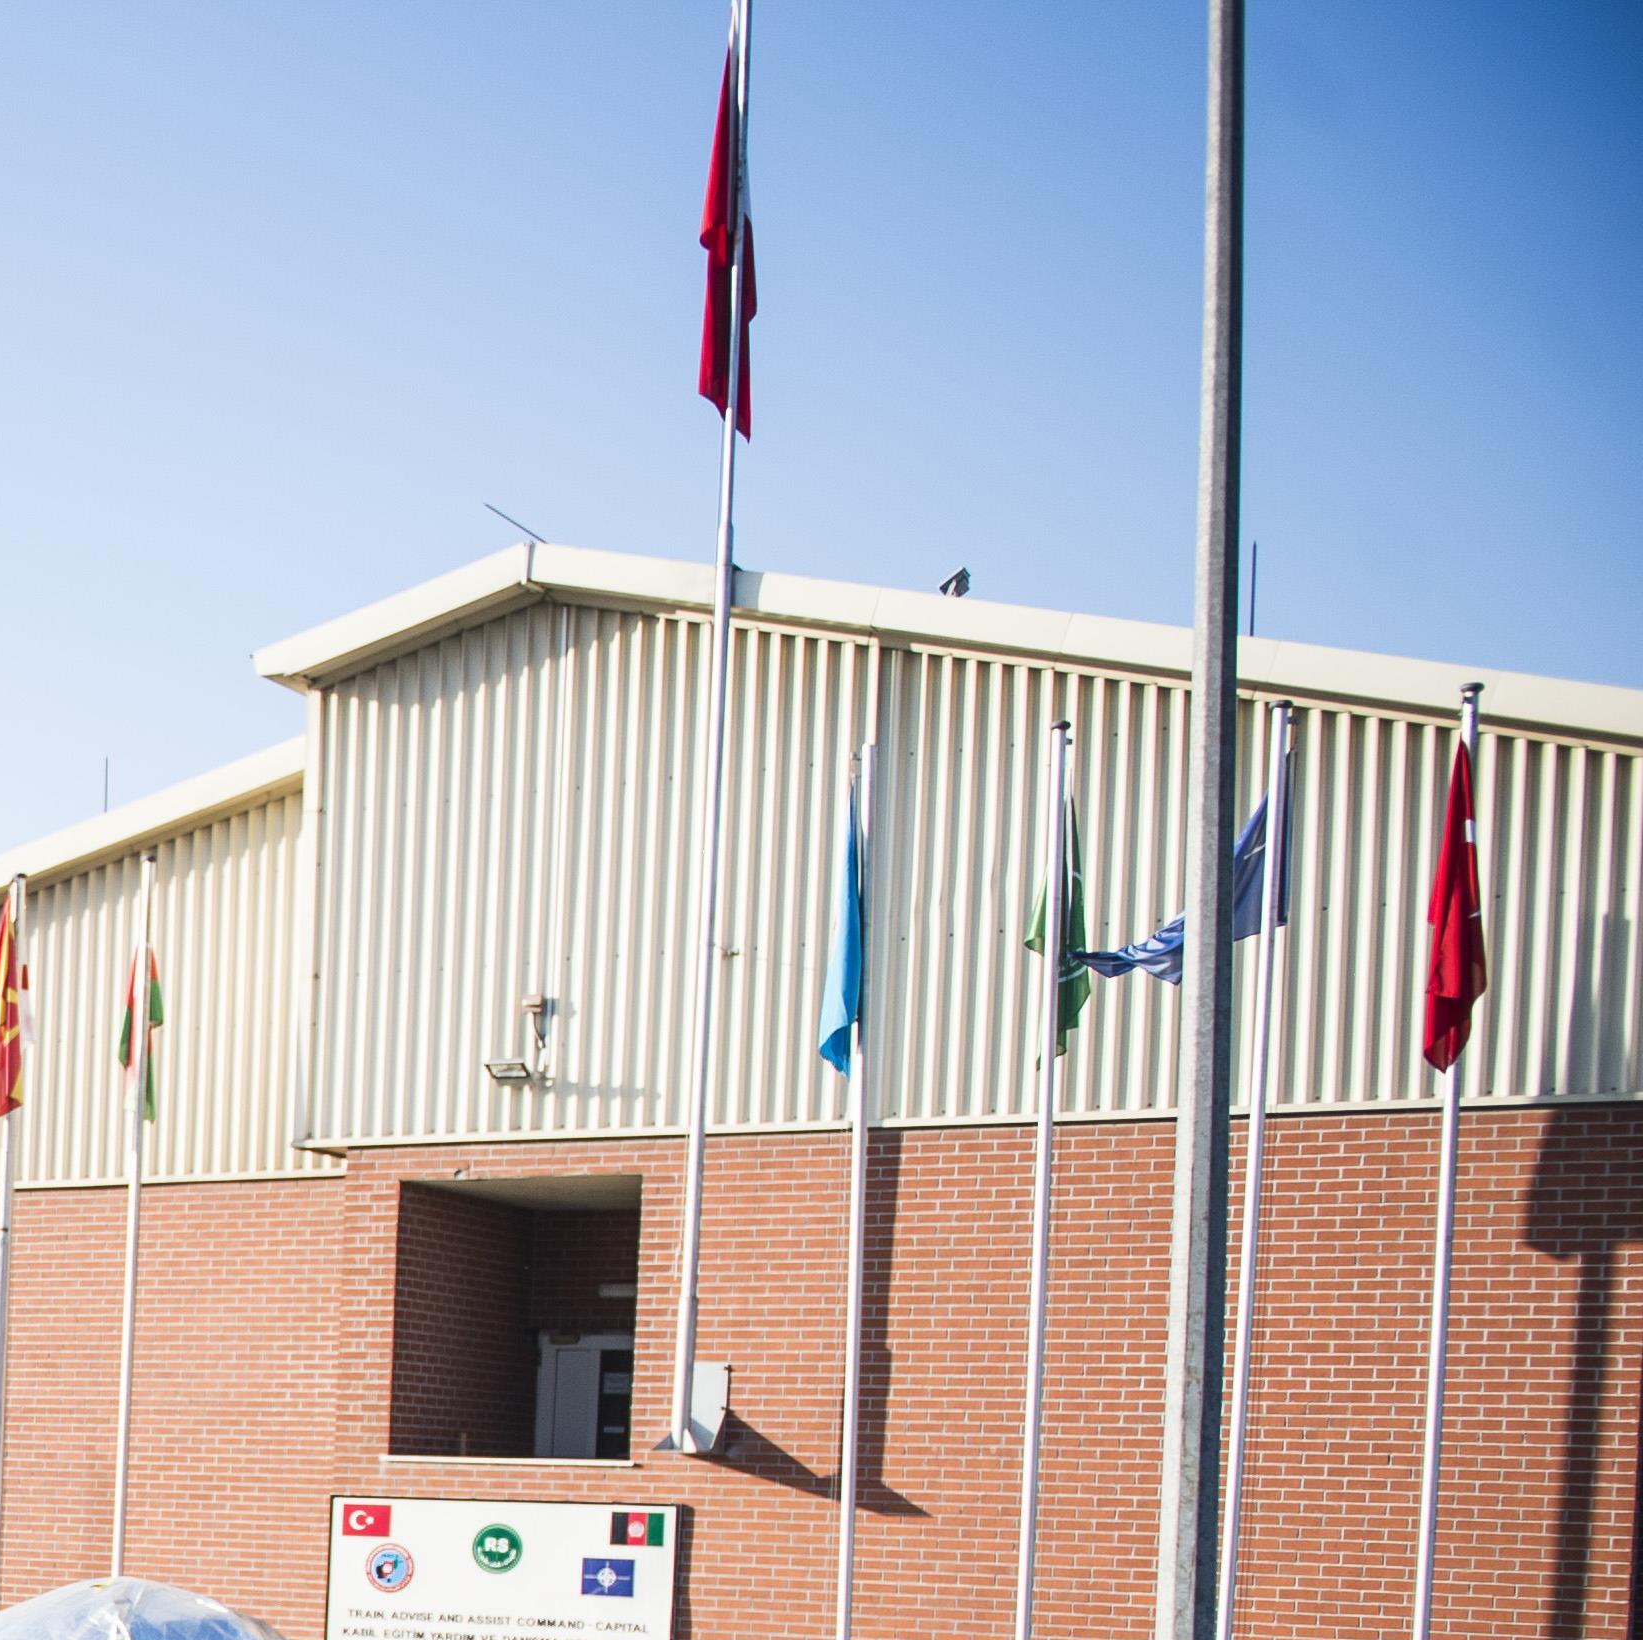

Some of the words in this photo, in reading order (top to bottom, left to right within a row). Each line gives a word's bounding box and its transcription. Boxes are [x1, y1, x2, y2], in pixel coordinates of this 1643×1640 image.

[483, 1536, 510, 1553] RS
[391, 1610, 433, 1622] ADVISE
[438, 1613, 463, 1623] AND
[467, 1614, 511, 1625] ASSIST
[517, 1616, 585, 1630] COMMAND
[595, 1621, 652, 1634] CAPITAL
